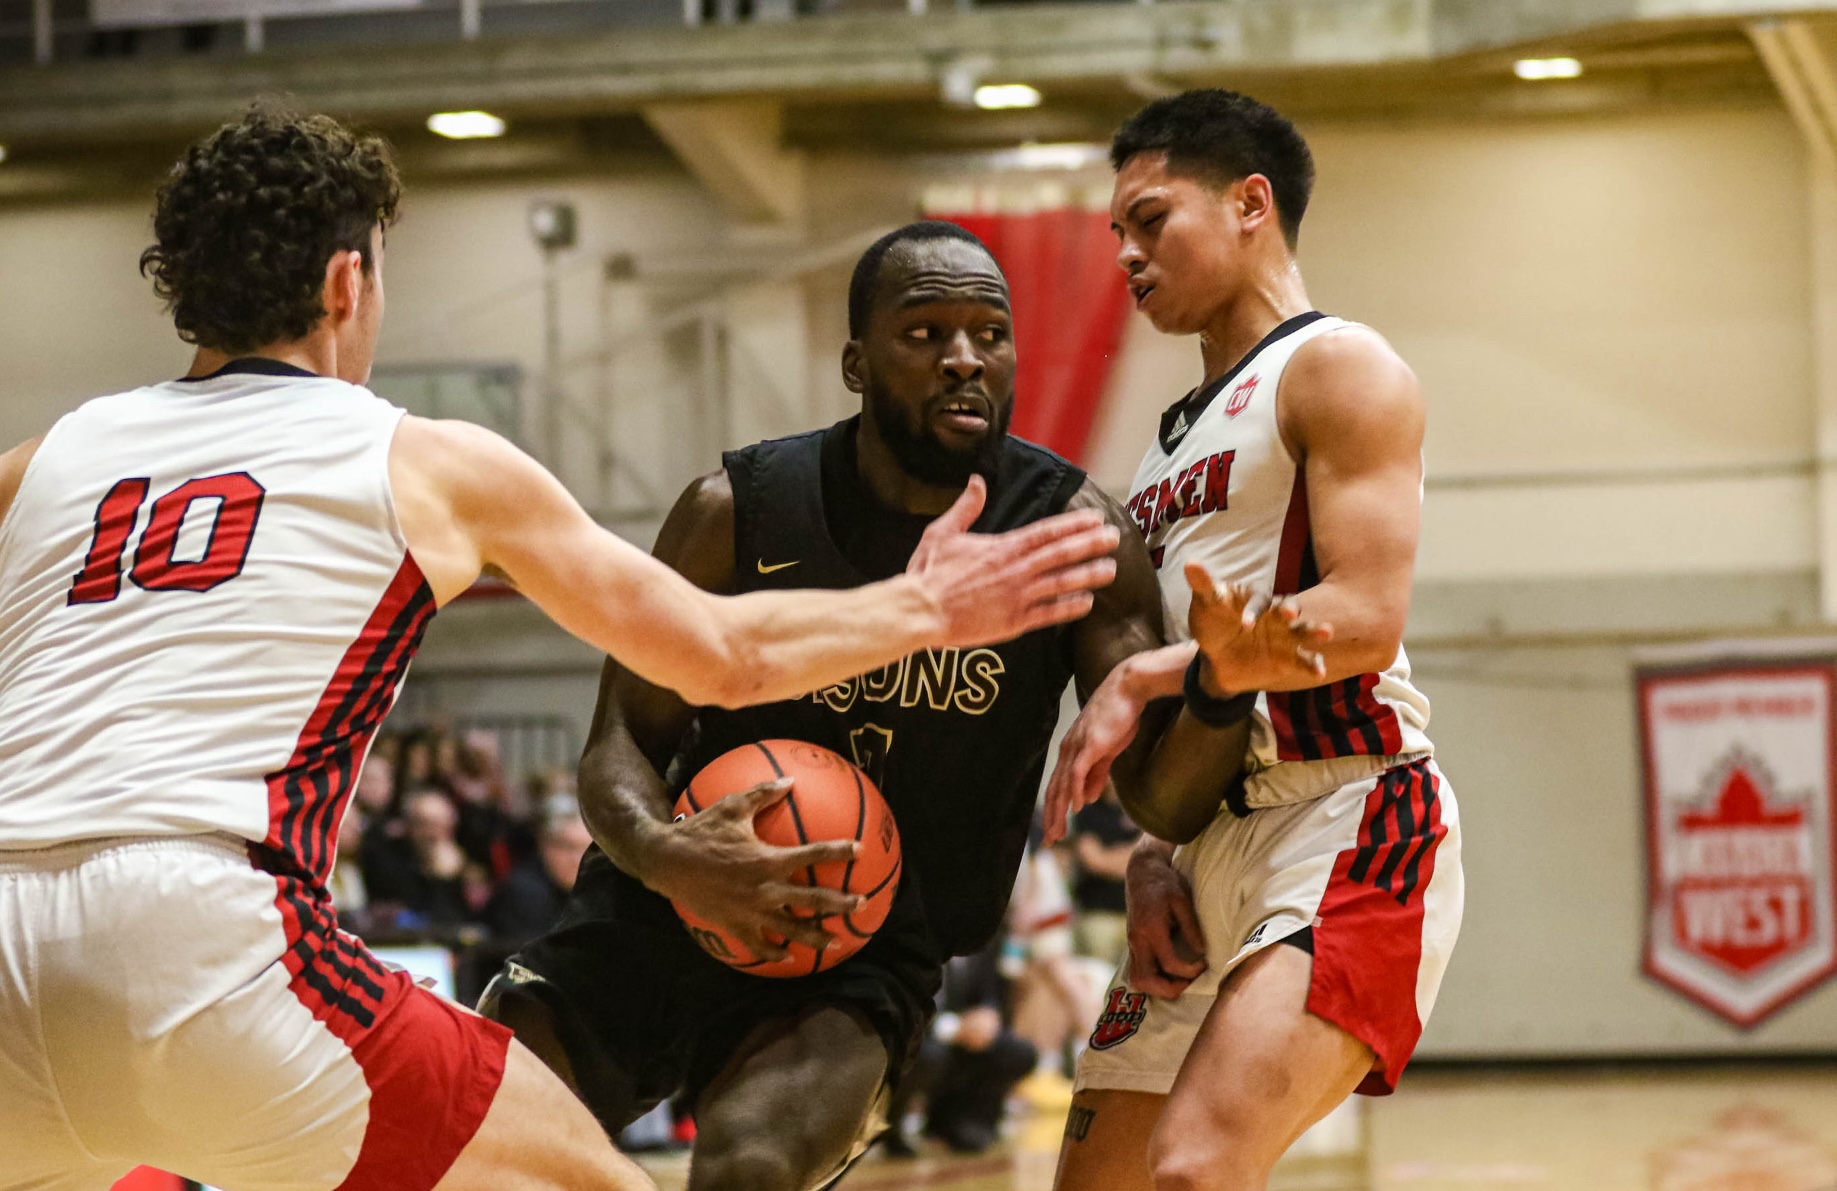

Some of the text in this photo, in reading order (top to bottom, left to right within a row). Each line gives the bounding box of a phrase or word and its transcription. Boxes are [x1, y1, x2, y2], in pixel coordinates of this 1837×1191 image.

[1126, 449, 1236, 541] SMEN
[67, 472, 266, 606] 10
[787, 646, 1005, 714] SONS
[1681, 884, 1802, 948] WEST
